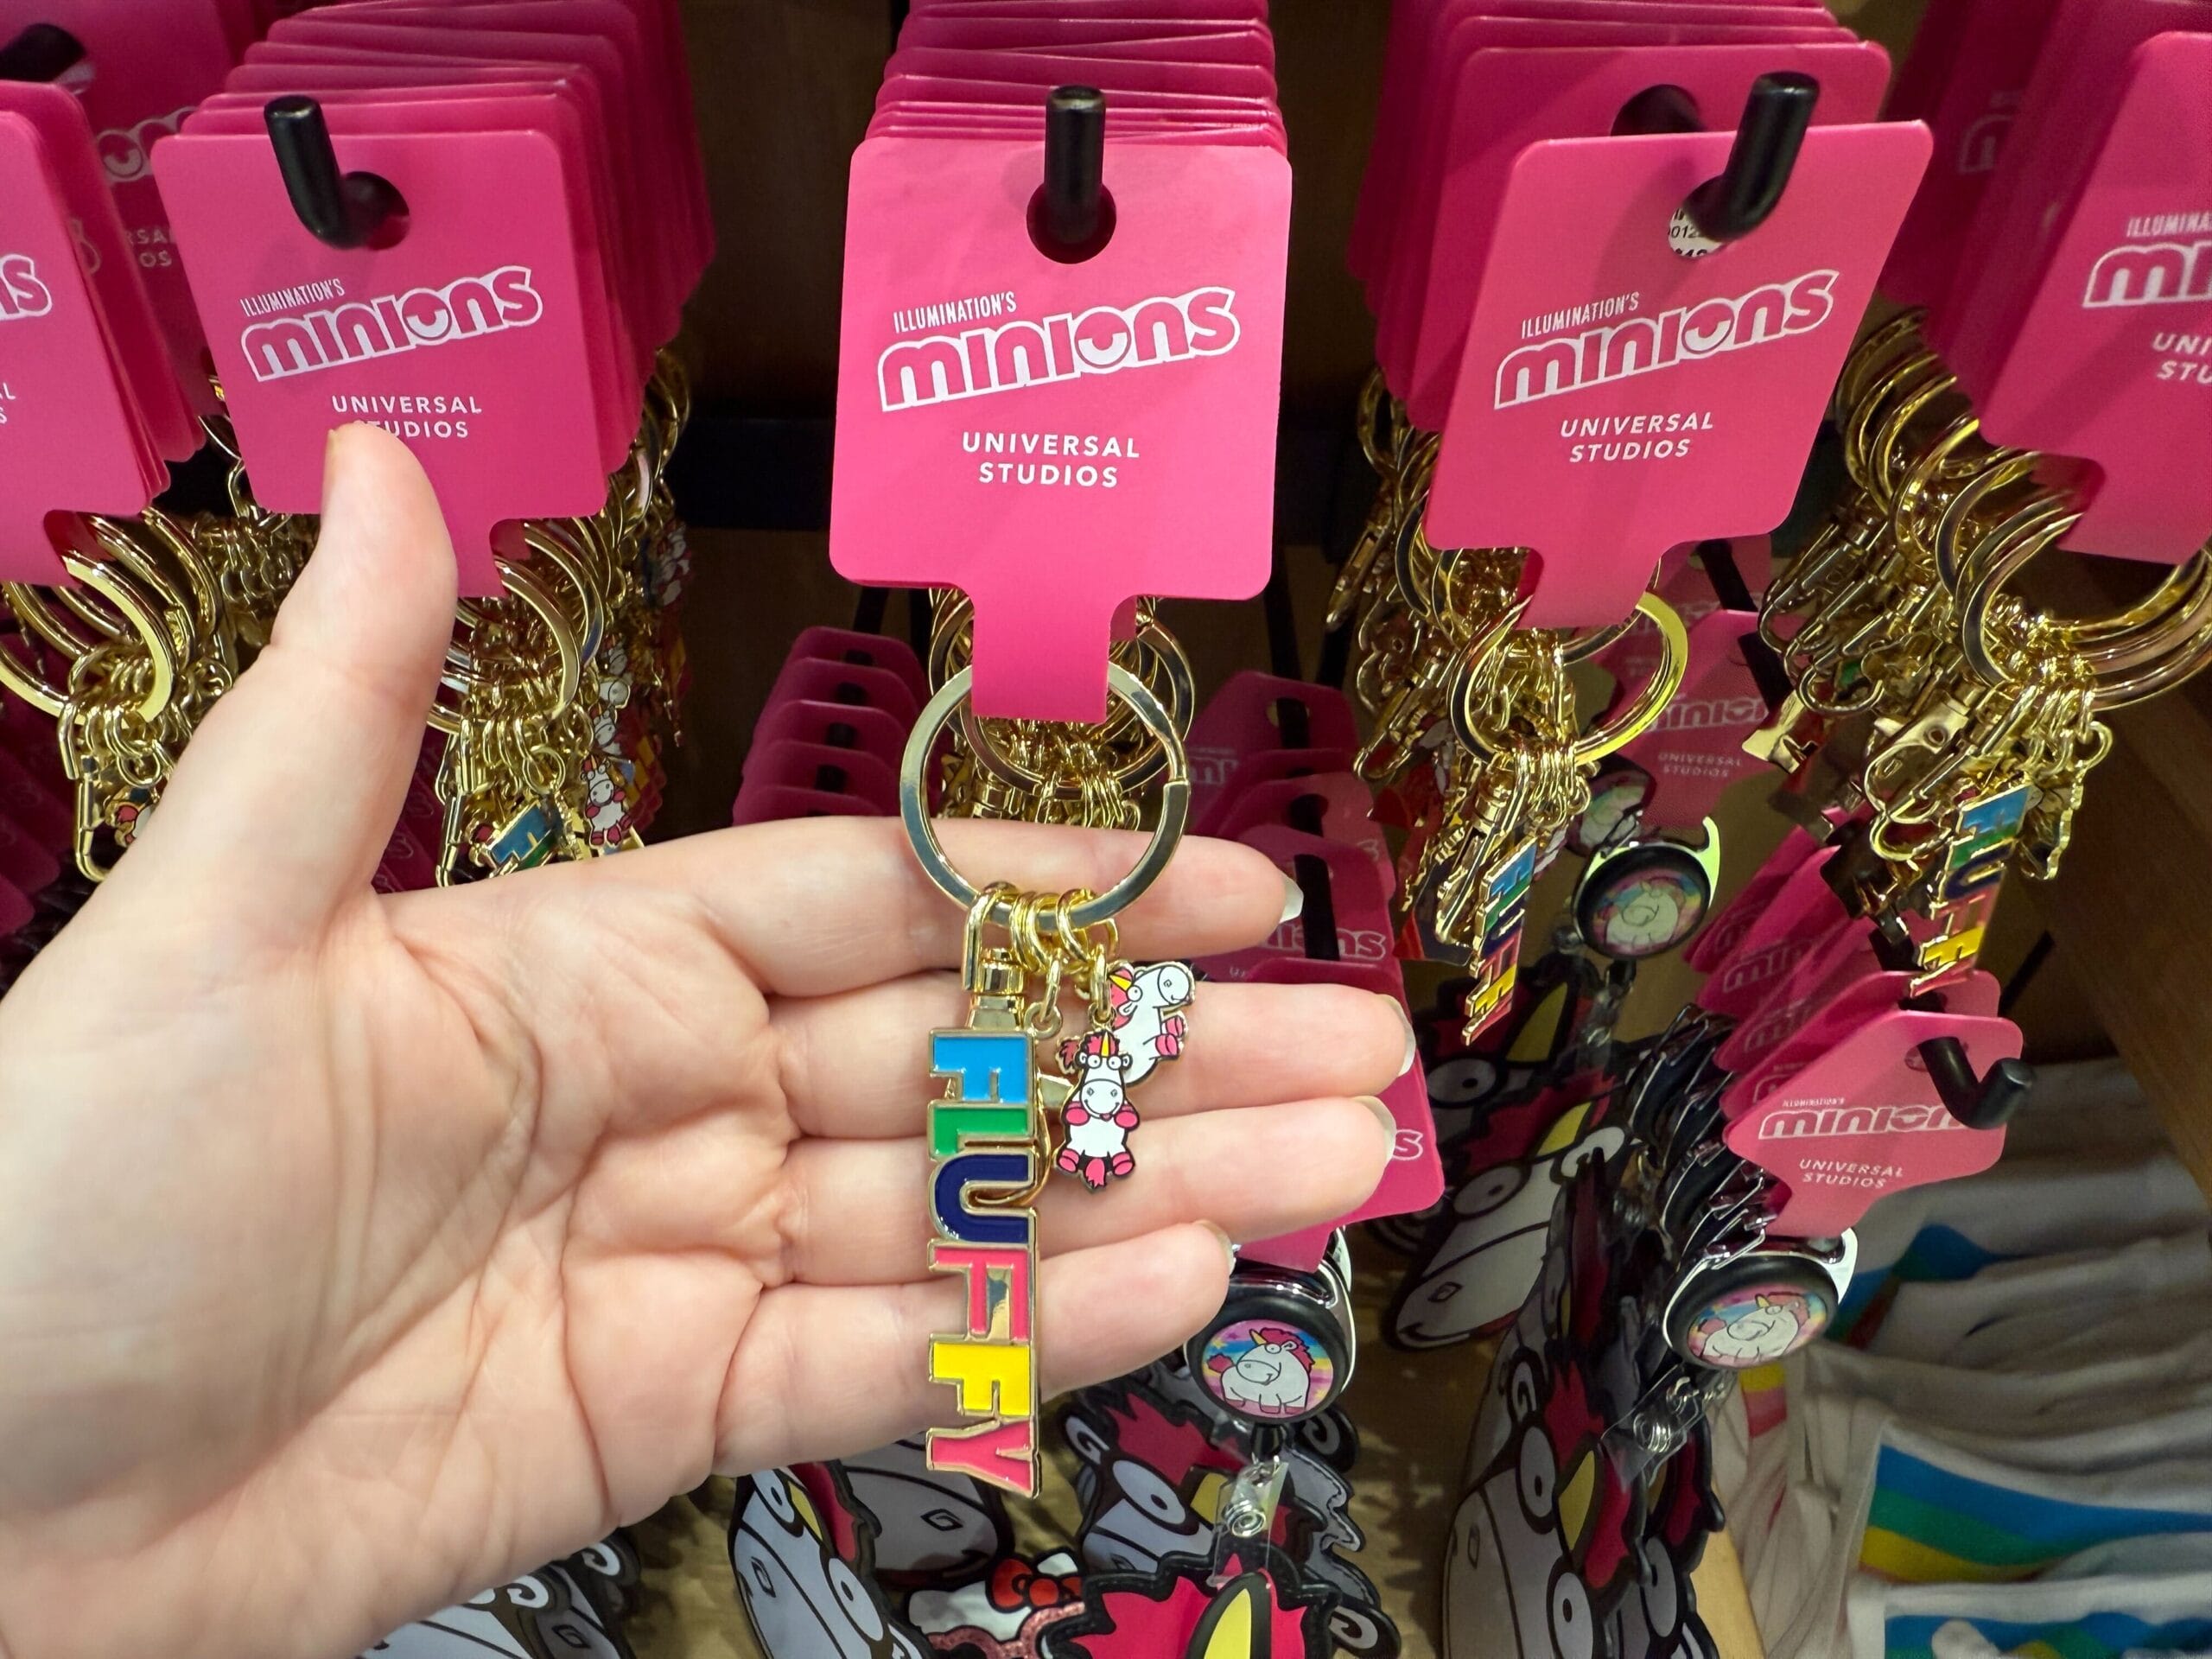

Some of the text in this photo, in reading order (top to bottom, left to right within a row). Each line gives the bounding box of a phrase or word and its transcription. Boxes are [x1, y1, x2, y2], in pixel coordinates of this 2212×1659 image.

[240, 278, 345, 316] ILLUMINATION'S
[893, 291, 1017, 333] ILLUMINATION'S
[1522, 291, 1640, 339] ILLUMINATION'S
[332, 395, 482, 415] UNIVERSAL
[367, 420, 469, 439] UDIOS
[1560, 411, 1714, 438] UNIVERSAL
[962, 431, 1141, 458] UNIVERSAL
[1569, 438, 1691, 463] STUDIOS
[979, 461, 1118, 488] STUDIOS
[1799, 1158, 1904, 1179] UNIVERSAL
[1802, 1172, 1887, 1189] STUDIOS
[926, 1028, 1041, 1499] FLUFFY
